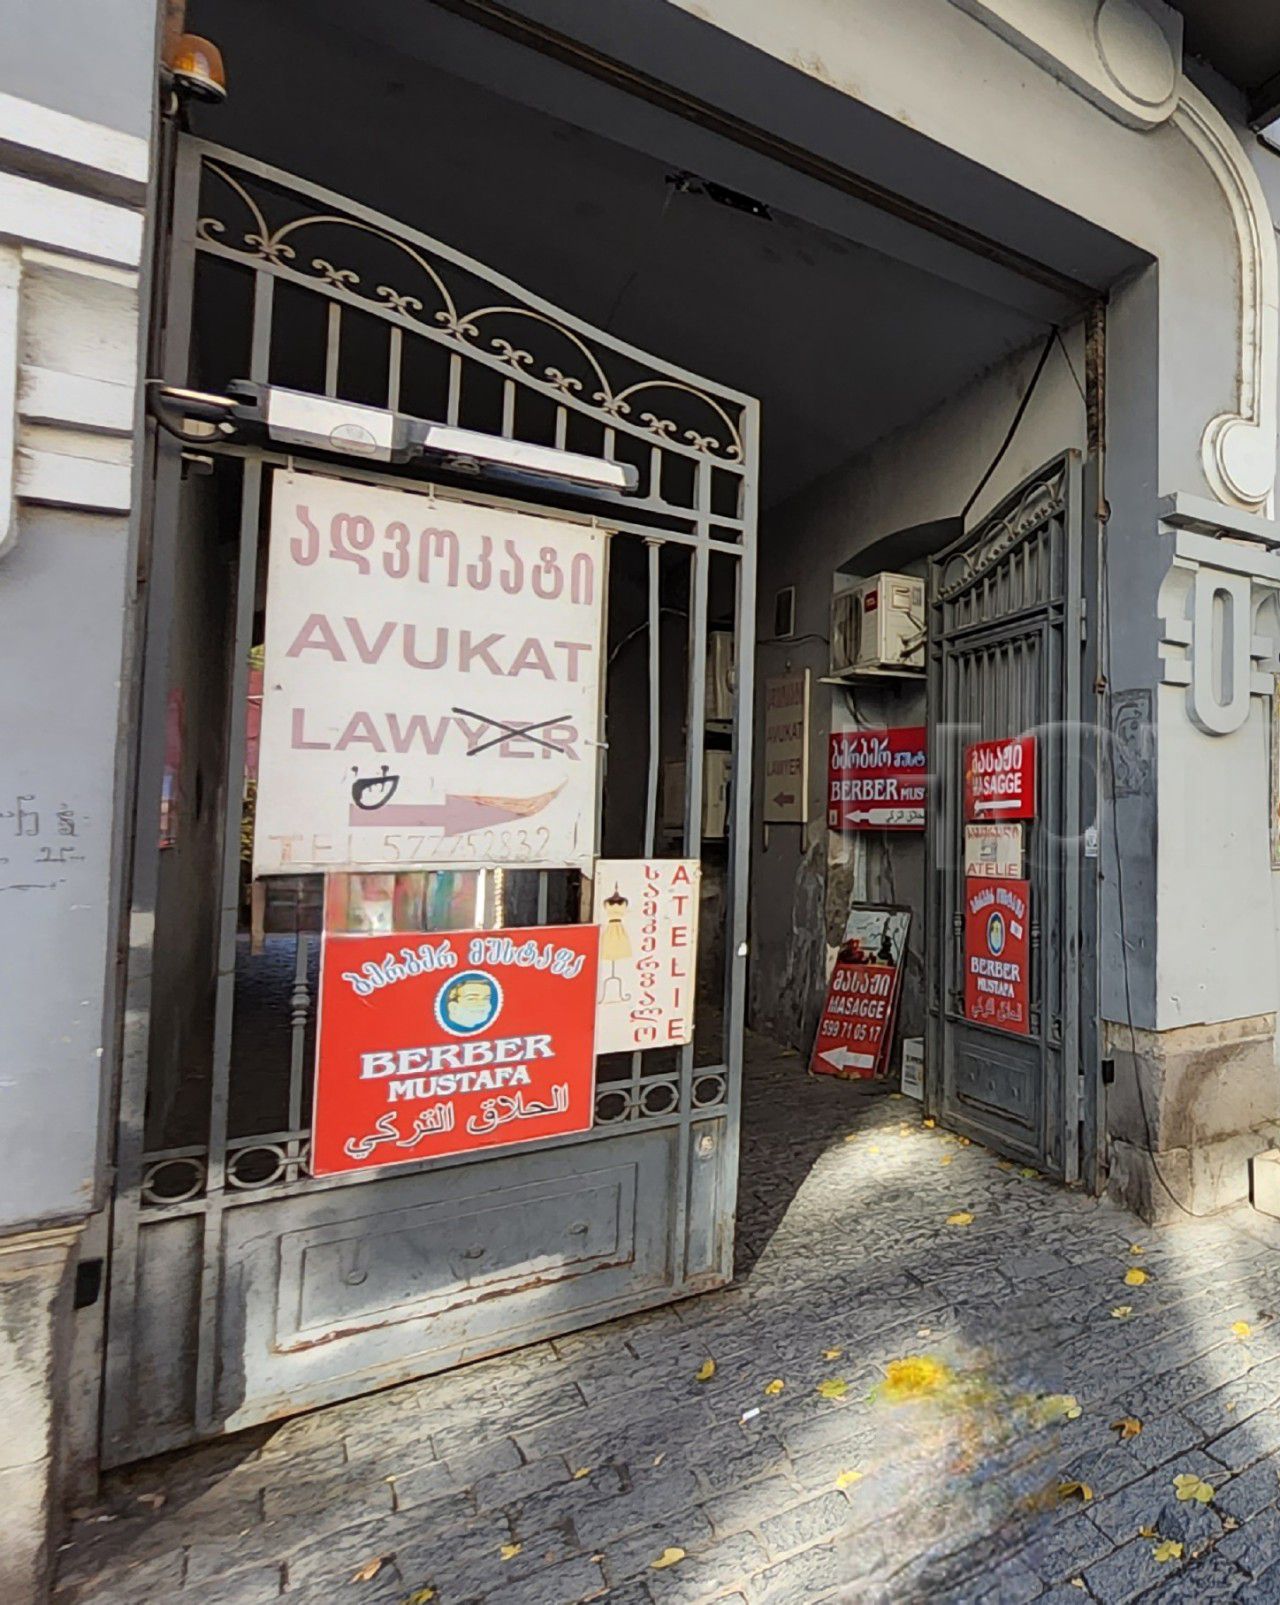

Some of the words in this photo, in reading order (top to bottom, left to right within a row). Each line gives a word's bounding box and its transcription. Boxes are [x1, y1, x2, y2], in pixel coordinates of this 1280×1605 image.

[289, 504, 594, 606] ადვოკატი
[285, 613, 593, 683] AVUKAT
[290, 707, 581, 761] LAWYER
[829, 778, 898, 801] BERBER
[967, 862, 1018, 878] ATELIE
[630, 864, 663, 1042] სამკერვალო
[667, 865, 690, 1040] ATELIE
[970, 956, 1021, 983] BERBER
[833, 969, 891, 997] მასაჟი
[827, 995, 886, 1019] MASAGGE
[841, 1022, 853, 1039] 71
[869, 1026, 882, 1043] 17
[359, 1034, 555, 1079] BERBER
[387, 1064, 532, 1102] MUSTAFA
[344, 1101, 455, 1159] التركي
[466, 1082, 570, 1135] الحلاق
